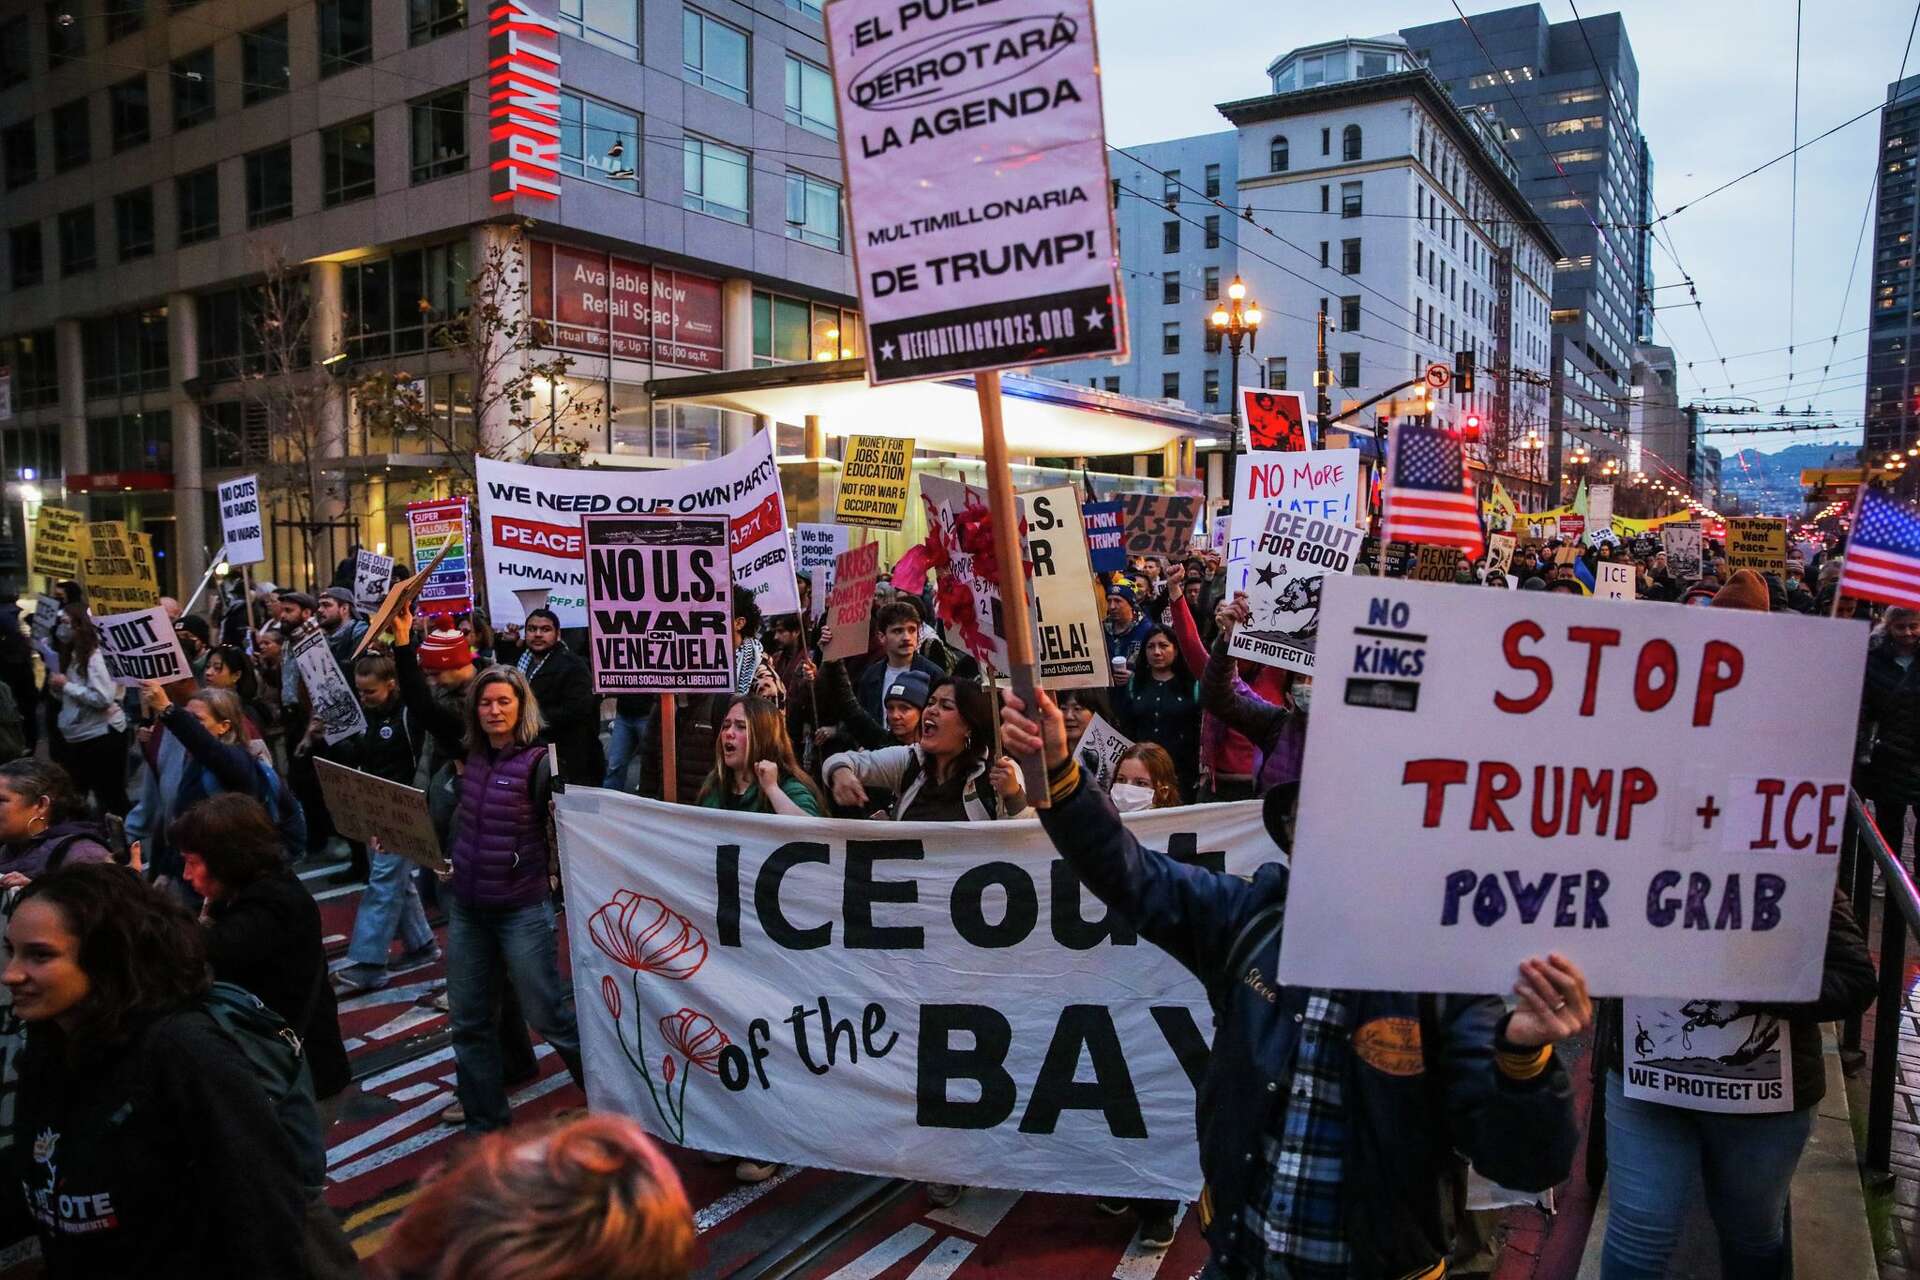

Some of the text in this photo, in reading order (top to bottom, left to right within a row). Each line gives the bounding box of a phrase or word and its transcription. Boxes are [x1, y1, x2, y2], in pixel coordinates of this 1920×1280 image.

[854, 13, 1076, 106] DERROTARÁ
[508, 0, 561, 196] TRINITY
[861, 79, 1081, 158] LA AGENDA
[867, 186, 1088, 247] MULTIMILLONARIA
[871, 230, 1096, 298] DE TRUMP!
[653, 281, 686, 303] Now
[633, 302, 680, 329] Space
[898, 307, 1075, 361] WEFIGHTBACK2025.ORG
[854, 448, 905, 465] JOBS AND
[857, 437, 904, 450] MONEY FOR
[846, 462, 906, 481] EDUCATION
[1248, 463, 1285, 499] NO
[221, 481, 256, 502] NO CUTS
[488, 481, 532, 505] WE
[536, 491, 611, 513] NEED
[678, 486, 730, 513] OWN
[841, 482, 860, 495] NOT
[860, 484, 877, 496] FOR
[877, 486, 899, 499] WAR
[224, 500, 257, 519] NO RAIDS
[414, 512, 439, 523] SUPER
[844, 498, 898, 515] OCCUPATION
[227, 525, 260, 543] NO WARS
[501, 525, 582, 552] PEACE
[801, 530, 834, 542] We the
[1264, 510, 1308, 539] ICE
[1306, 520, 1359, 551] OUT
[1729, 519, 1782, 532] The People
[1742, 531, 1769, 542] Want
[801, 544, 833, 556] people
[1089, 531, 1122, 550] TRUMP
[1257, 533, 1295, 559] FOR
[1296, 541, 1350, 572] GOOD
[1733, 541, 1766, 552] Peace
[358, 560, 390, 577] FOR GOOD
[359, 551, 393, 569] ICE OUT
[498, 562, 568, 585] HUMAN
[753, 547, 787, 572] GREED
[801, 556, 837, 567] deserv
[1728, 556, 1784, 568] Not War on
[590, 548, 646, 602] NO
[652, 548, 726, 602] U.S.
[1419, 566, 1457, 582] GOOD
[1604, 566, 1628, 583] ICE
[422, 586, 447, 598] POTUS
[594, 610, 728, 636] WAR
[1368, 597, 1411, 629] NO
[108, 614, 159, 652] OUT
[649, 631, 673, 640] ON
[596, 638, 729, 670] VENEZUELA
[1233, 635, 1251, 650] WE
[1253, 640, 1306, 663] PROTECT
[116, 651, 181, 680] GOOD!
[1056, 664, 1091, 673] Liberation
[1493, 618, 1744, 728] STOP
[601, 674, 728, 686] PARTY FOR SOCIALISM & LIBERATION
[1402, 757, 1658, 841] TRUMP
[1749, 778, 1846, 855] ICE
[716, 838, 926, 951] ICE
[1440, 868, 1787, 932] POWER GRAB
[1244, 967, 1277, 1003] Steve
[718, 1017, 771, 1092] of
[783, 995, 900, 1076] the
[1628, 1066, 1784, 1101] WE PROTECT US
